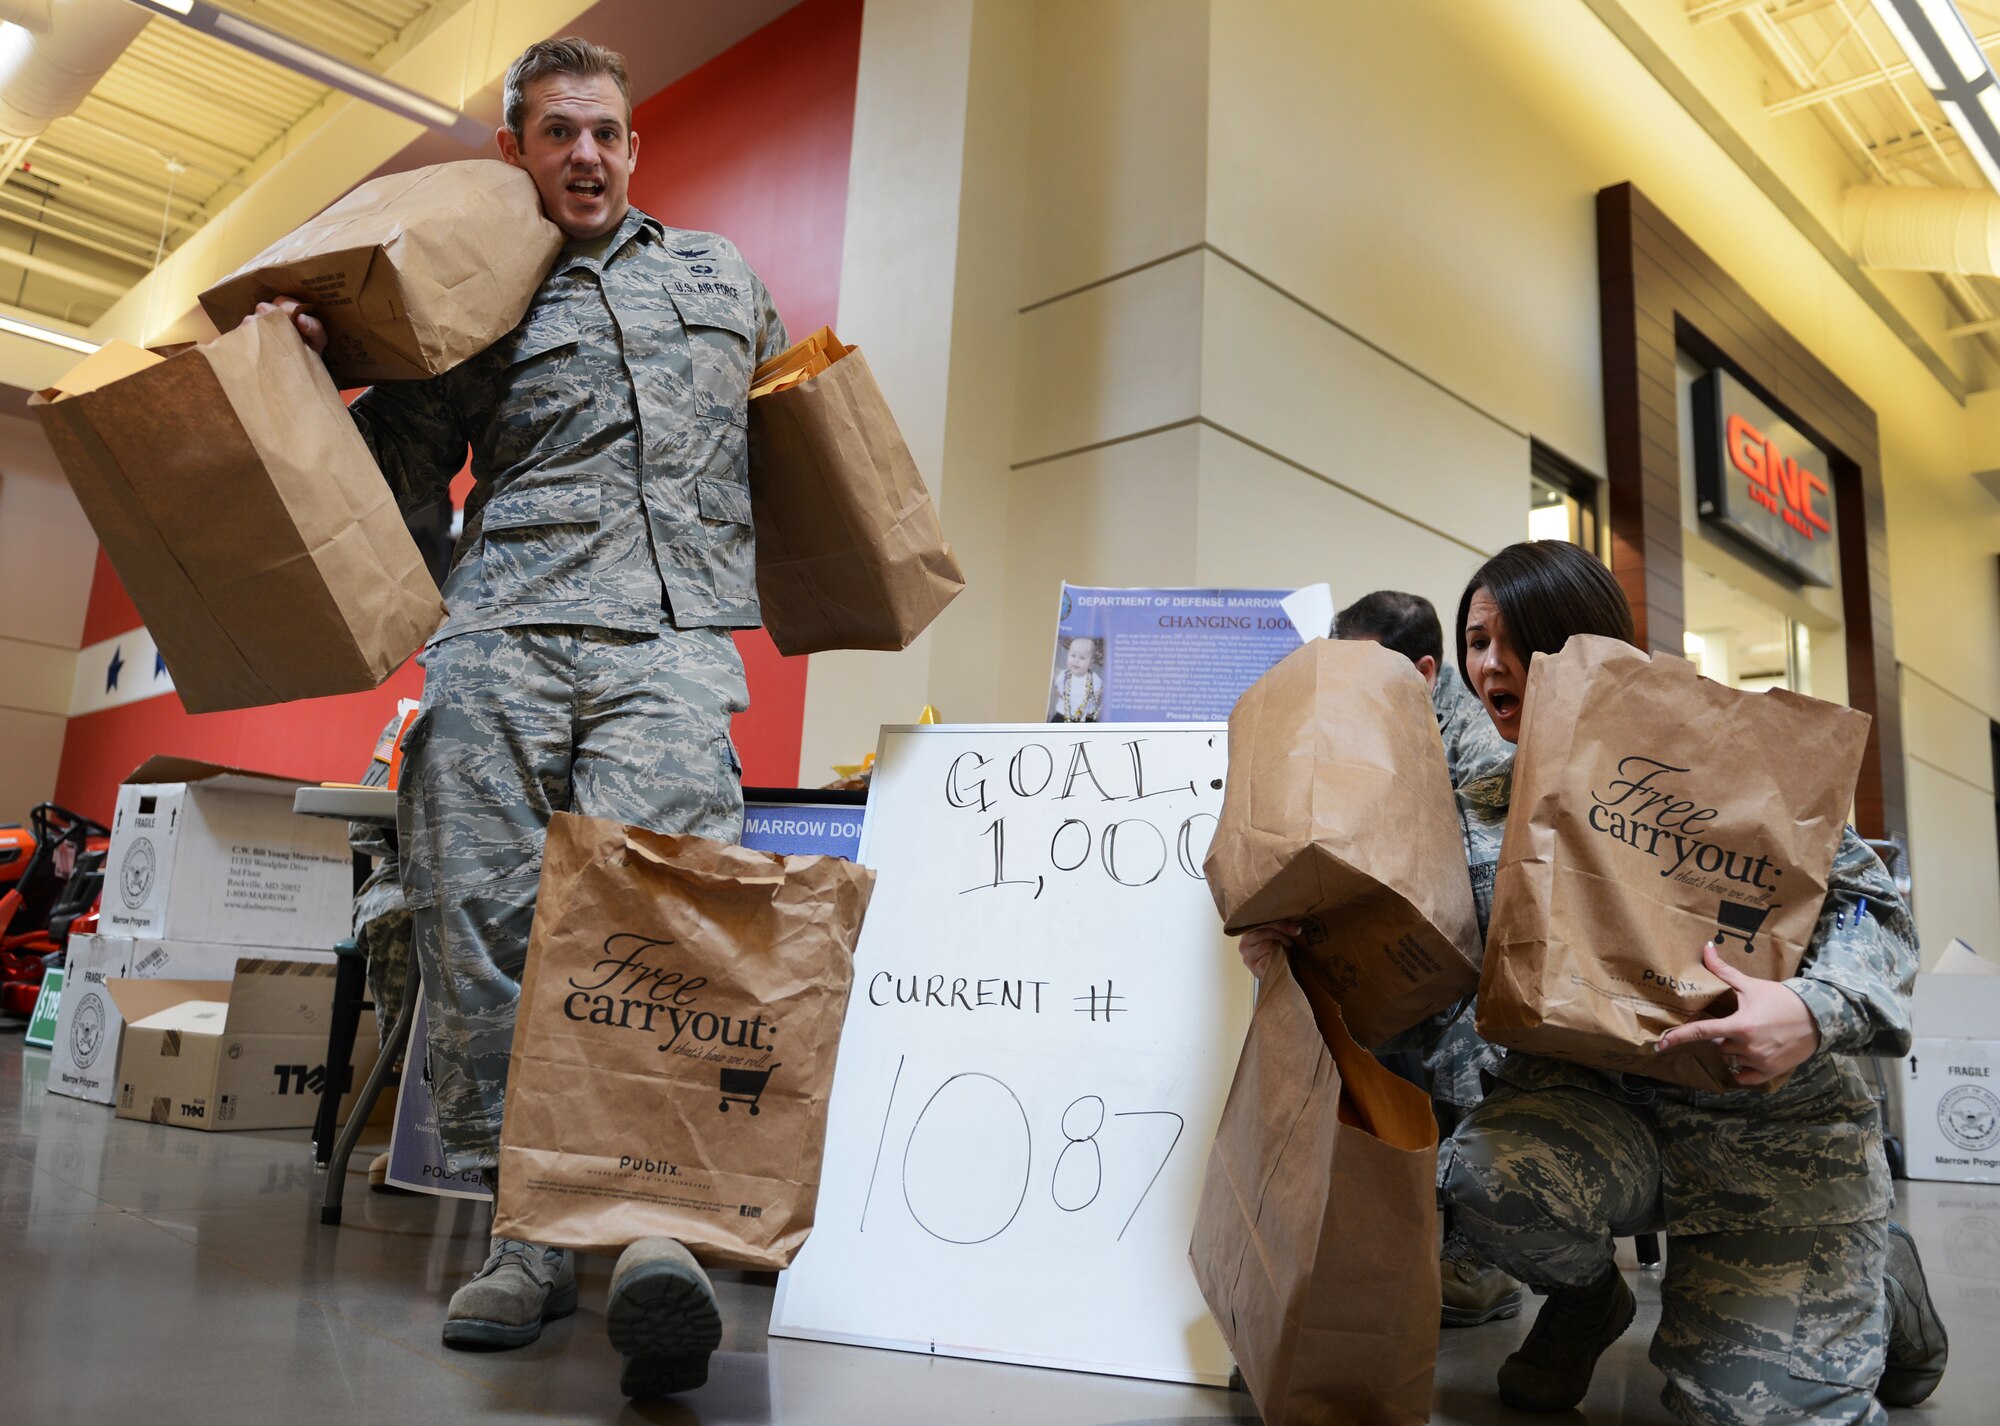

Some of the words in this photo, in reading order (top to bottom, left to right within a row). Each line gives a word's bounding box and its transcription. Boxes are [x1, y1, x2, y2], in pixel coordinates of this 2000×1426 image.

[674, 282, 696, 292] U.S.
[698, 283, 713, 294] AIR
[715, 283, 739, 300] FORCE
[1727, 413, 1831, 534] GNC
[1078, 596, 1152, 607] DEPARTMENT
[1154, 597, 1169, 607] OF
[1172, 597, 1225, 608] DEFENSE
[1227, 598, 1281, 608] MARROW
[1158, 615, 1251, 629] CHANGING
[1166, 711, 1191, 720] Please
[1192, 712, 1209, 721] Help
[946, 735, 1224, 814] GOAL:
[1591, 756, 1719, 836] Free
[134, 817, 156, 829] FRAGILE
[745, 818, 826, 836] MARROW
[252, 847, 266, 856] Bill
[266, 847, 290, 860] Young
[291, 851, 320, 862] Marrow
[1588, 804, 1784, 893] carryout:
[241, 868, 262, 878] Floor
[289, 862, 309, 872] Drive
[264, 882, 279, 890] MD
[1674, 870, 1706, 888] that's
[1704, 878, 1728, 894] how
[1728, 888, 1745, 900] we
[112, 915, 130, 926] Marrow
[130, 916, 151, 929] Program
[568, 932, 709, 1006] Free
[1641, 969, 1697, 991] Publix
[868, 971, 1050, 1013] CURRENT
[1072, 979, 1129, 1022] #
[563, 990, 778, 1053] carryout:
[672, 1041, 702, 1060] that's
[703, 1046, 727, 1064] how
[726, 1054, 744, 1067] we
[1948, 1066, 1990, 1077] FRAGILE
[62, 1073, 79, 1085] Marrow
[79, 1076, 100, 1089] Program
[180, 1103, 205, 1119] DELL
[860, 1053, 1185, 1245] 1087
[619, 1155, 679, 1177] Publix
[1935, 1156, 1971, 1166] Marrow
